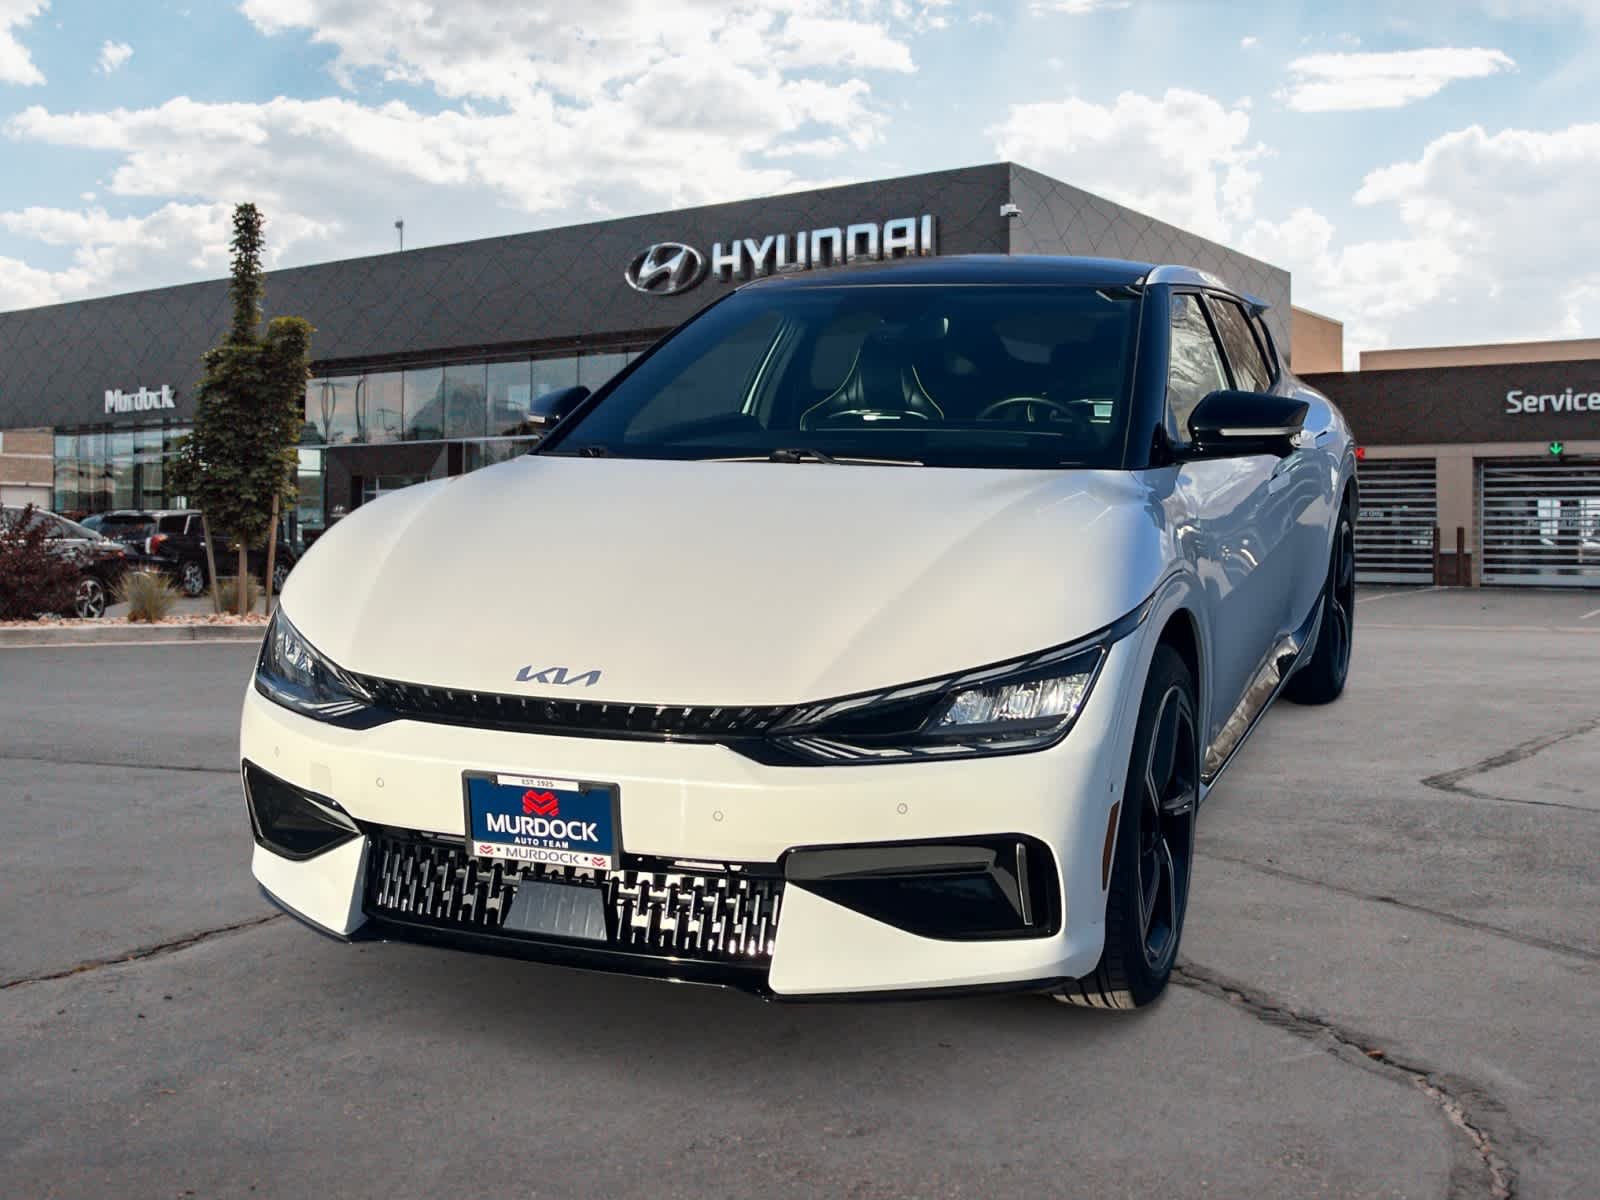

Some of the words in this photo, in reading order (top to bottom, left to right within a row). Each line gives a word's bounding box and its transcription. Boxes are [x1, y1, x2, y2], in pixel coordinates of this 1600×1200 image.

[712, 214, 933, 275] HYUNDAI
[104, 384, 176, 413] Murdock
[1506, 387, 1600, 414] Service
[515, 665, 601, 687] KIA
[486, 813, 599, 842] MURDOCK
[505, 847, 580, 864] MURDOCK
[514, 837, 539, 846] AUTO
[543, 839, 569, 849] TEAM
